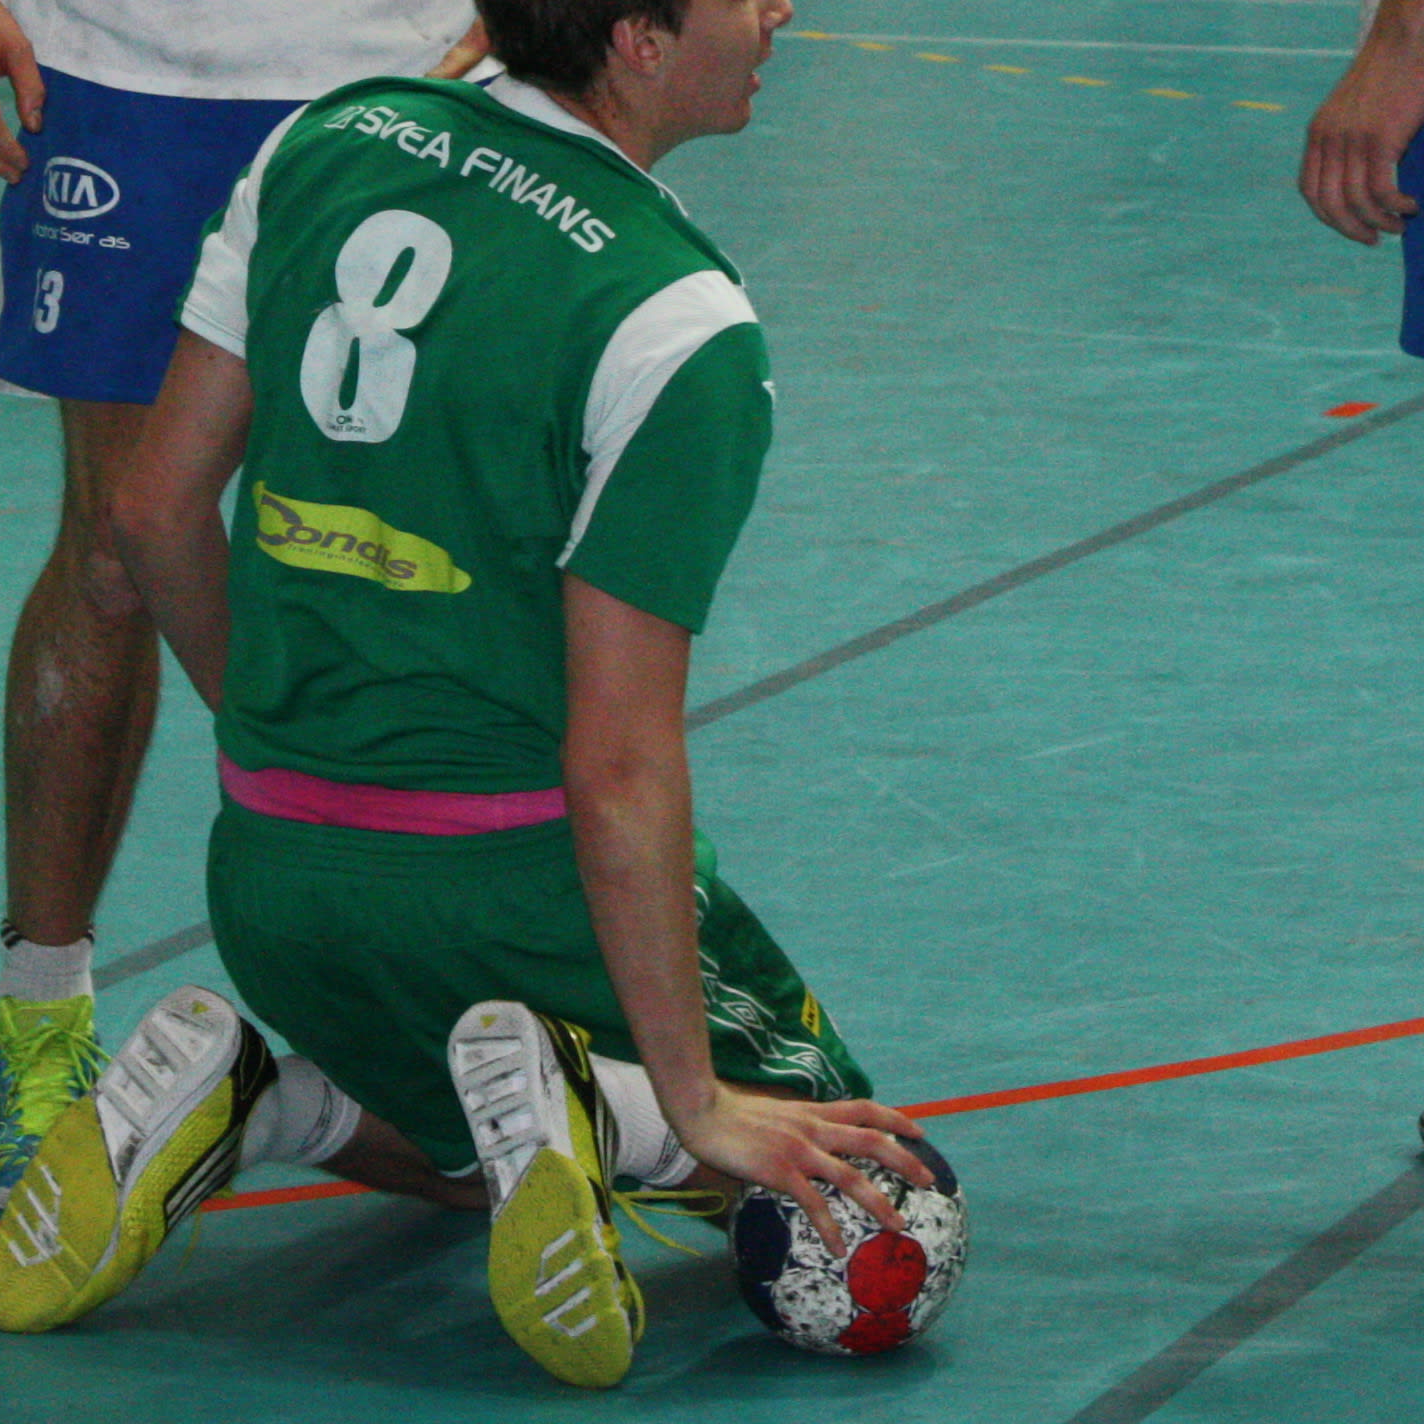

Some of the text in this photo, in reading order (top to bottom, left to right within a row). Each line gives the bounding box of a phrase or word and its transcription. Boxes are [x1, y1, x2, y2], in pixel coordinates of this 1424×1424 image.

[48, 170, 98, 207] KIA
[354, 106, 616, 253] SVEA FINANS
[98, 235, 131, 250] as
[299, 209, 453, 444] 8
